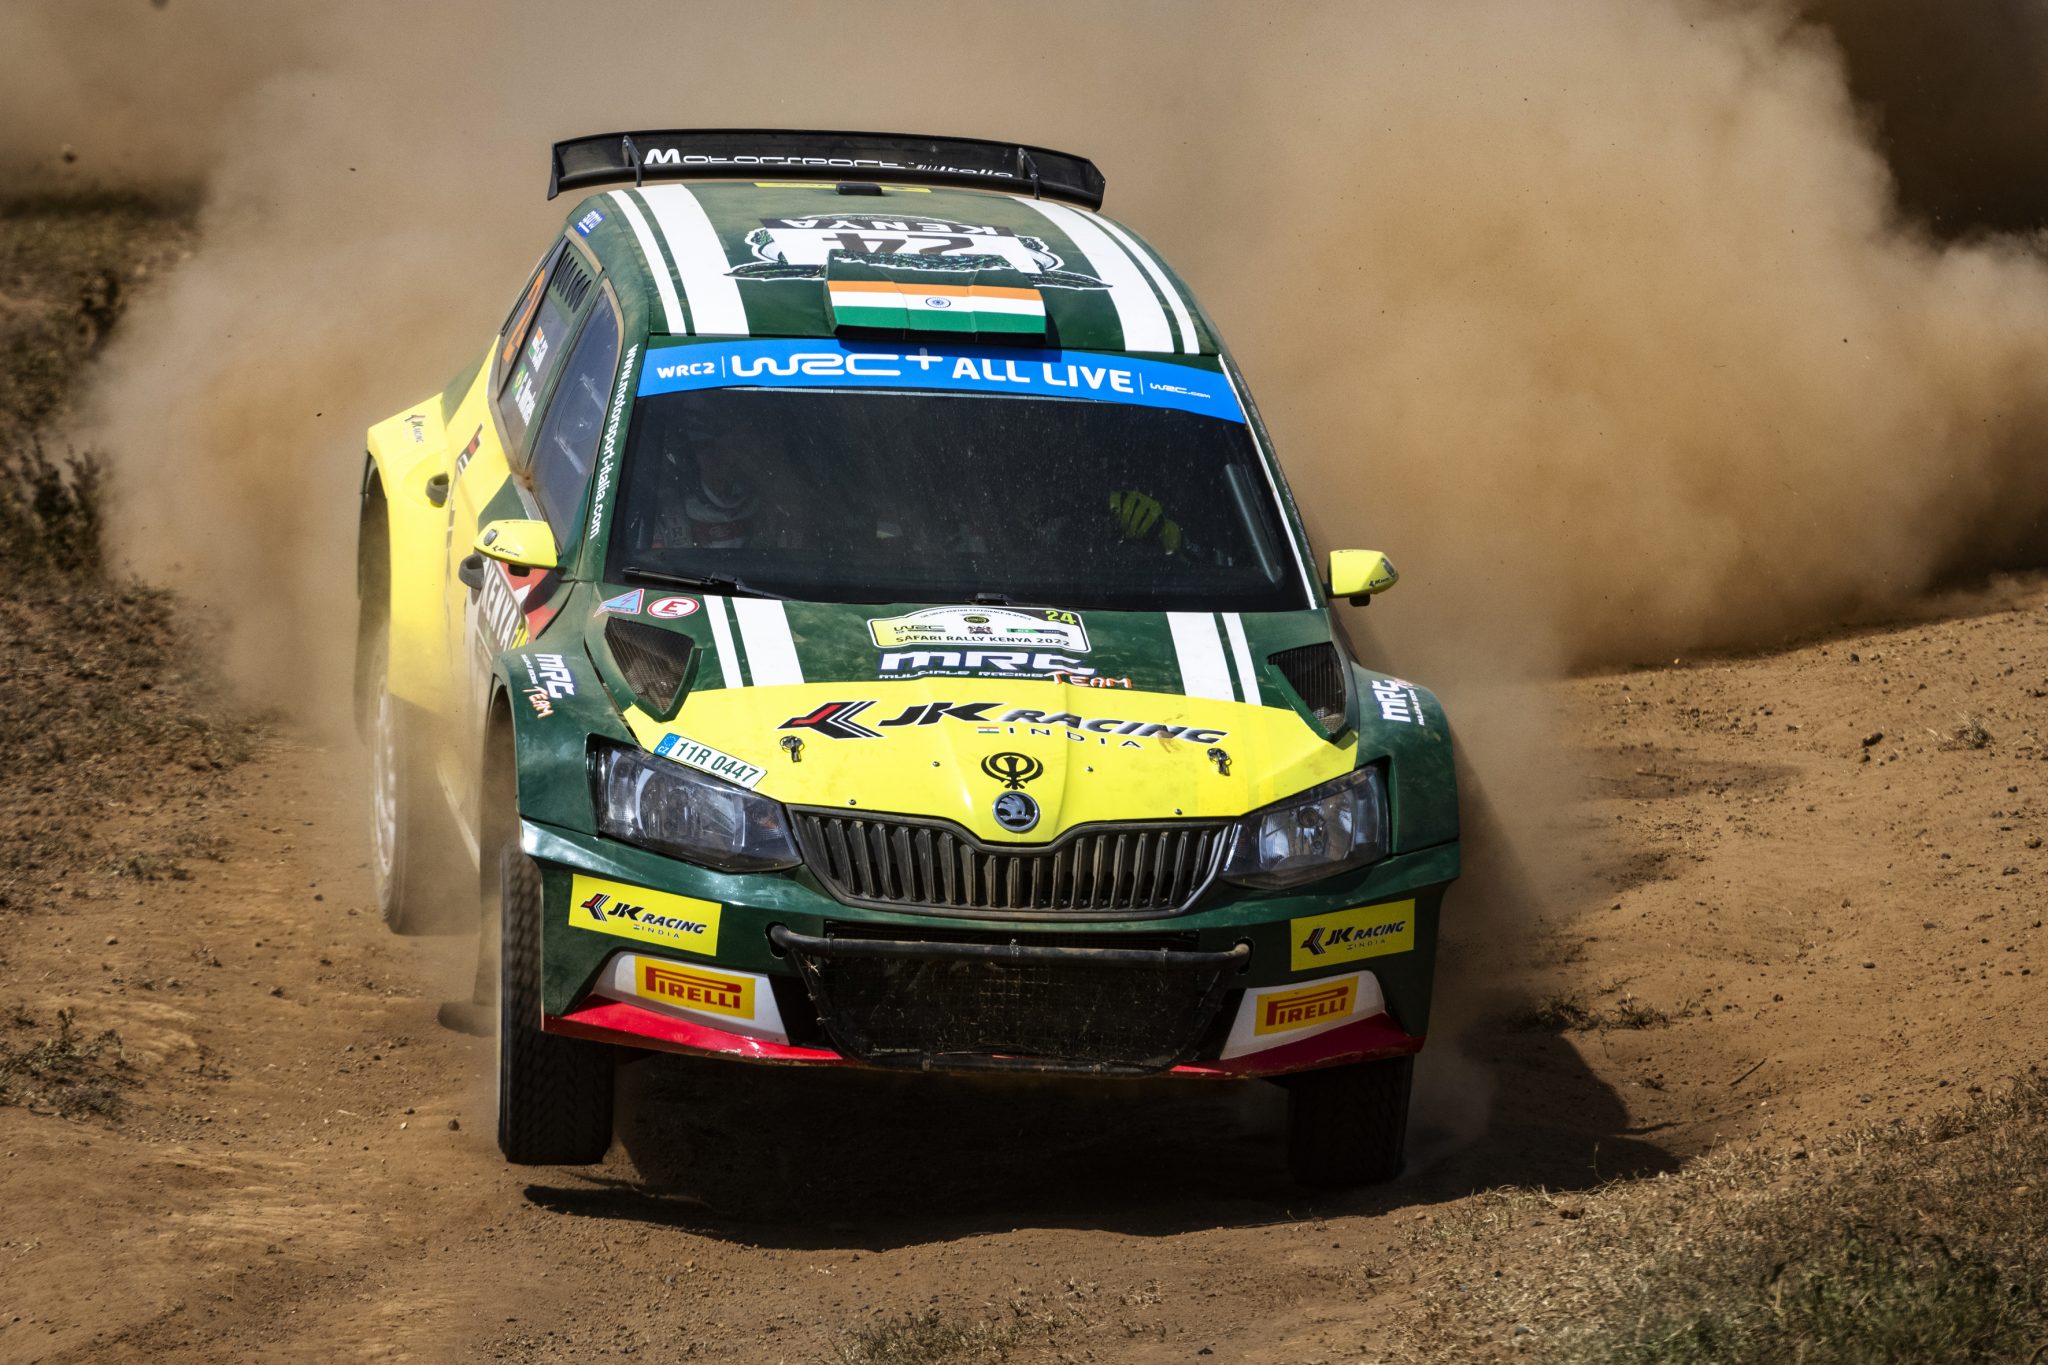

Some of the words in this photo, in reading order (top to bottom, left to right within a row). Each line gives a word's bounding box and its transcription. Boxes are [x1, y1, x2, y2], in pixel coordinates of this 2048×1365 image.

[780, 218, 999, 236] KENYA
[822, 232, 974, 255] 24
[657, 362, 715, 379] WRC2
[952, 357, 1030, 384] ALL
[1042, 363, 1134, 393] LIVE
[590, 343, 639, 540] www.motorsport-italia.com
[661, 601, 687, 613] E
[1045, 610, 1077, 625] 24
[1036, 637, 1070, 646] 2022
[522, 685, 554, 718] TEAM
[878, 702, 1005, 727] JK
[998, 709, 1228, 744] RACING
[1009, 726, 1143, 748] INDIA
[657, 746, 670, 754] CZ
[676, 742, 712, 765] 11R
[710, 755, 759, 782] 0447
[607, 902, 645, 922] JK
[641, 913, 707, 935] RACING
[641, 925, 680, 939] INDIA
[1325, 926, 1355, 947] JK
[1353, 920, 1406, 941] RACING
[1354, 938, 1386, 948] INDIA
[645, 965, 742, 1009] PIRELLI
[1265, 986, 1349, 1026] PIRELLI
